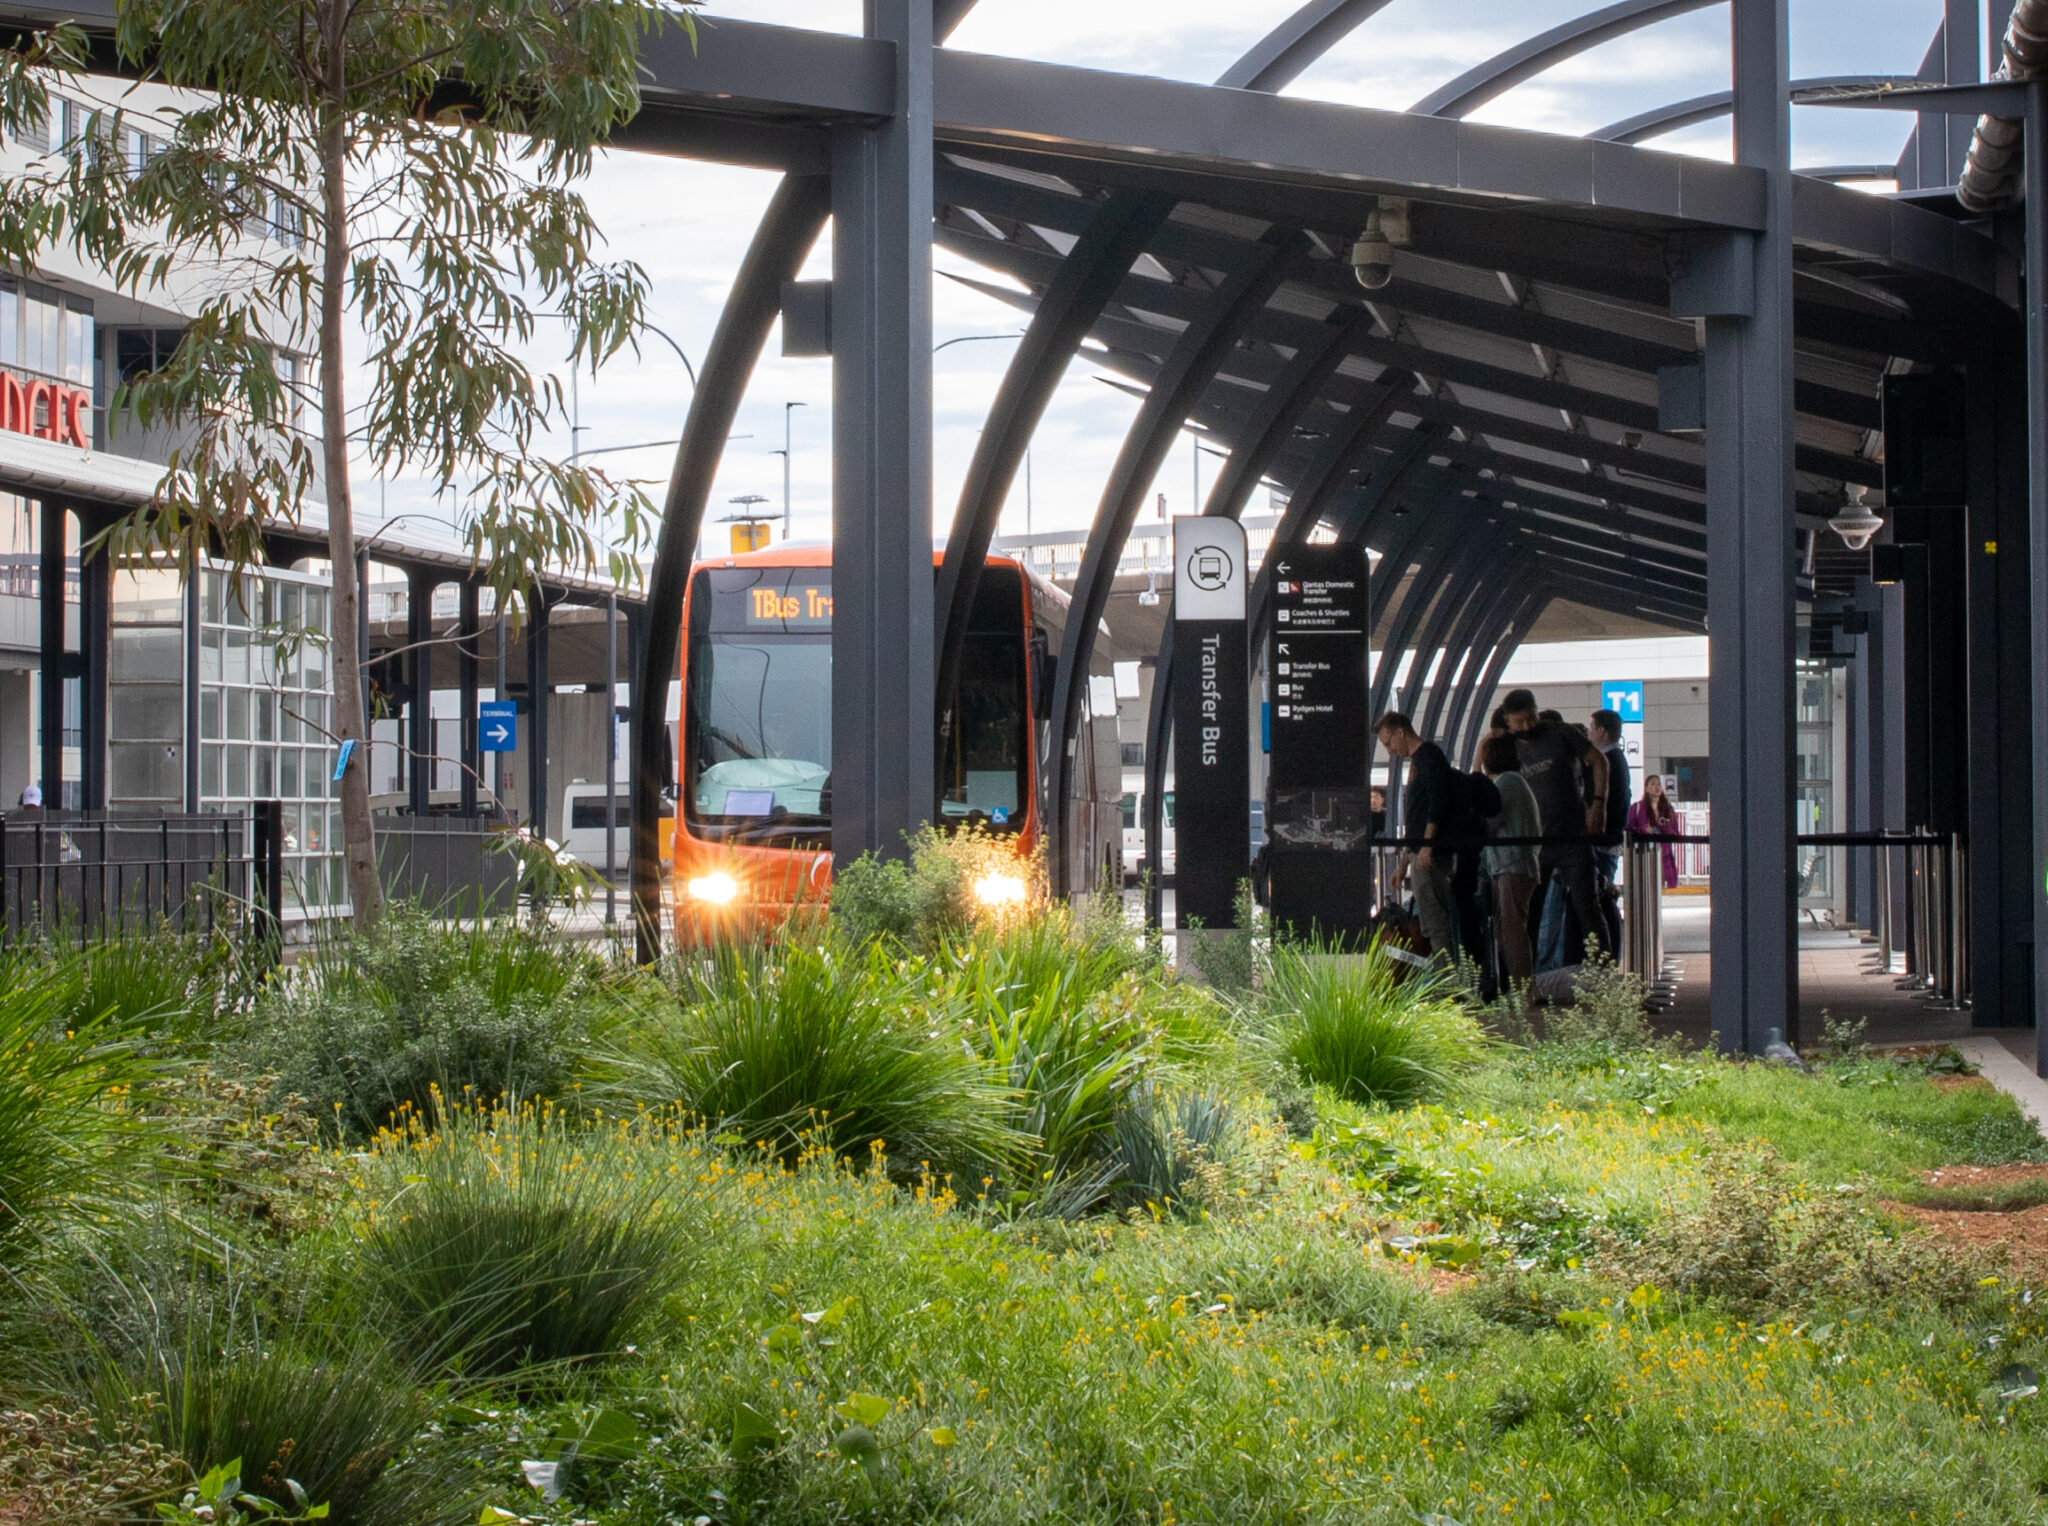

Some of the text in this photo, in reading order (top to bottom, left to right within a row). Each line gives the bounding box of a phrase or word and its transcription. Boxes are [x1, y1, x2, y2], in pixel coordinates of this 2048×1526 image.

[1302, 581, 1355, 590] Qantas Domestic
[752, 588, 800, 619] TBus
[1291, 609, 1317, 617] Coaches
[1292, 662, 1331, 670] Transfer Bus
[1202, 633, 1221, 765] Transfer Bus
[1607, 691, 1639, 712] T1
[1292, 704, 1333, 713] Rydges Hotel
[481, 710, 514, 718] TERMINAL
